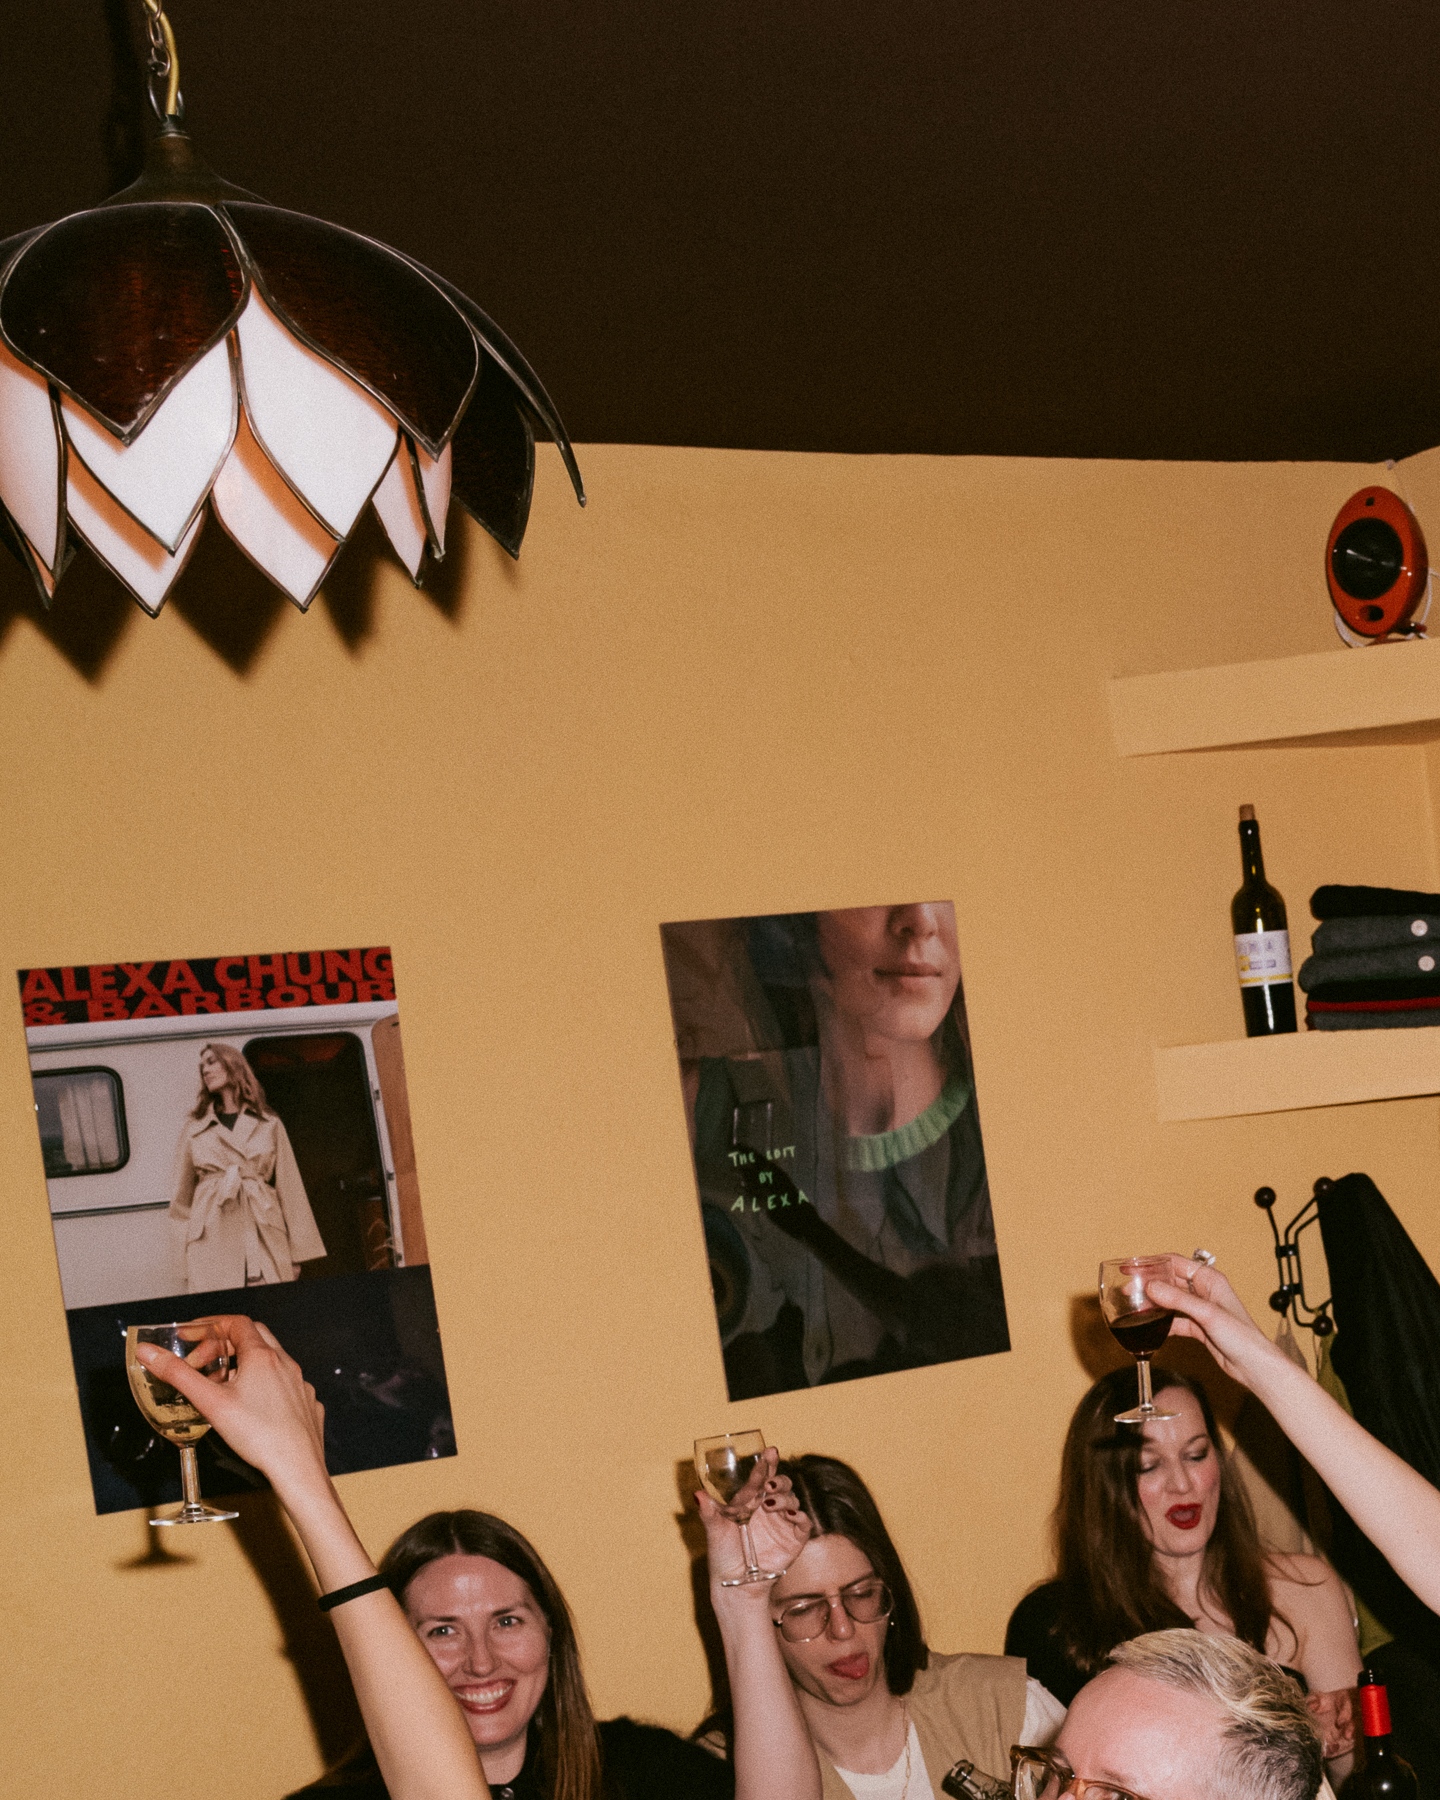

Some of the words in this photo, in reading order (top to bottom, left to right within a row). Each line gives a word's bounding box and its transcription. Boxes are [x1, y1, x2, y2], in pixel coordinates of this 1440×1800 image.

[21, 959, 203, 1002] ALEXA
[214, 947, 395, 990] CHUNG
[23, 1001, 70, 1027] &
[86, 981, 397, 1023] BARBOUR
[731, 1189, 809, 1213] ALEXA
